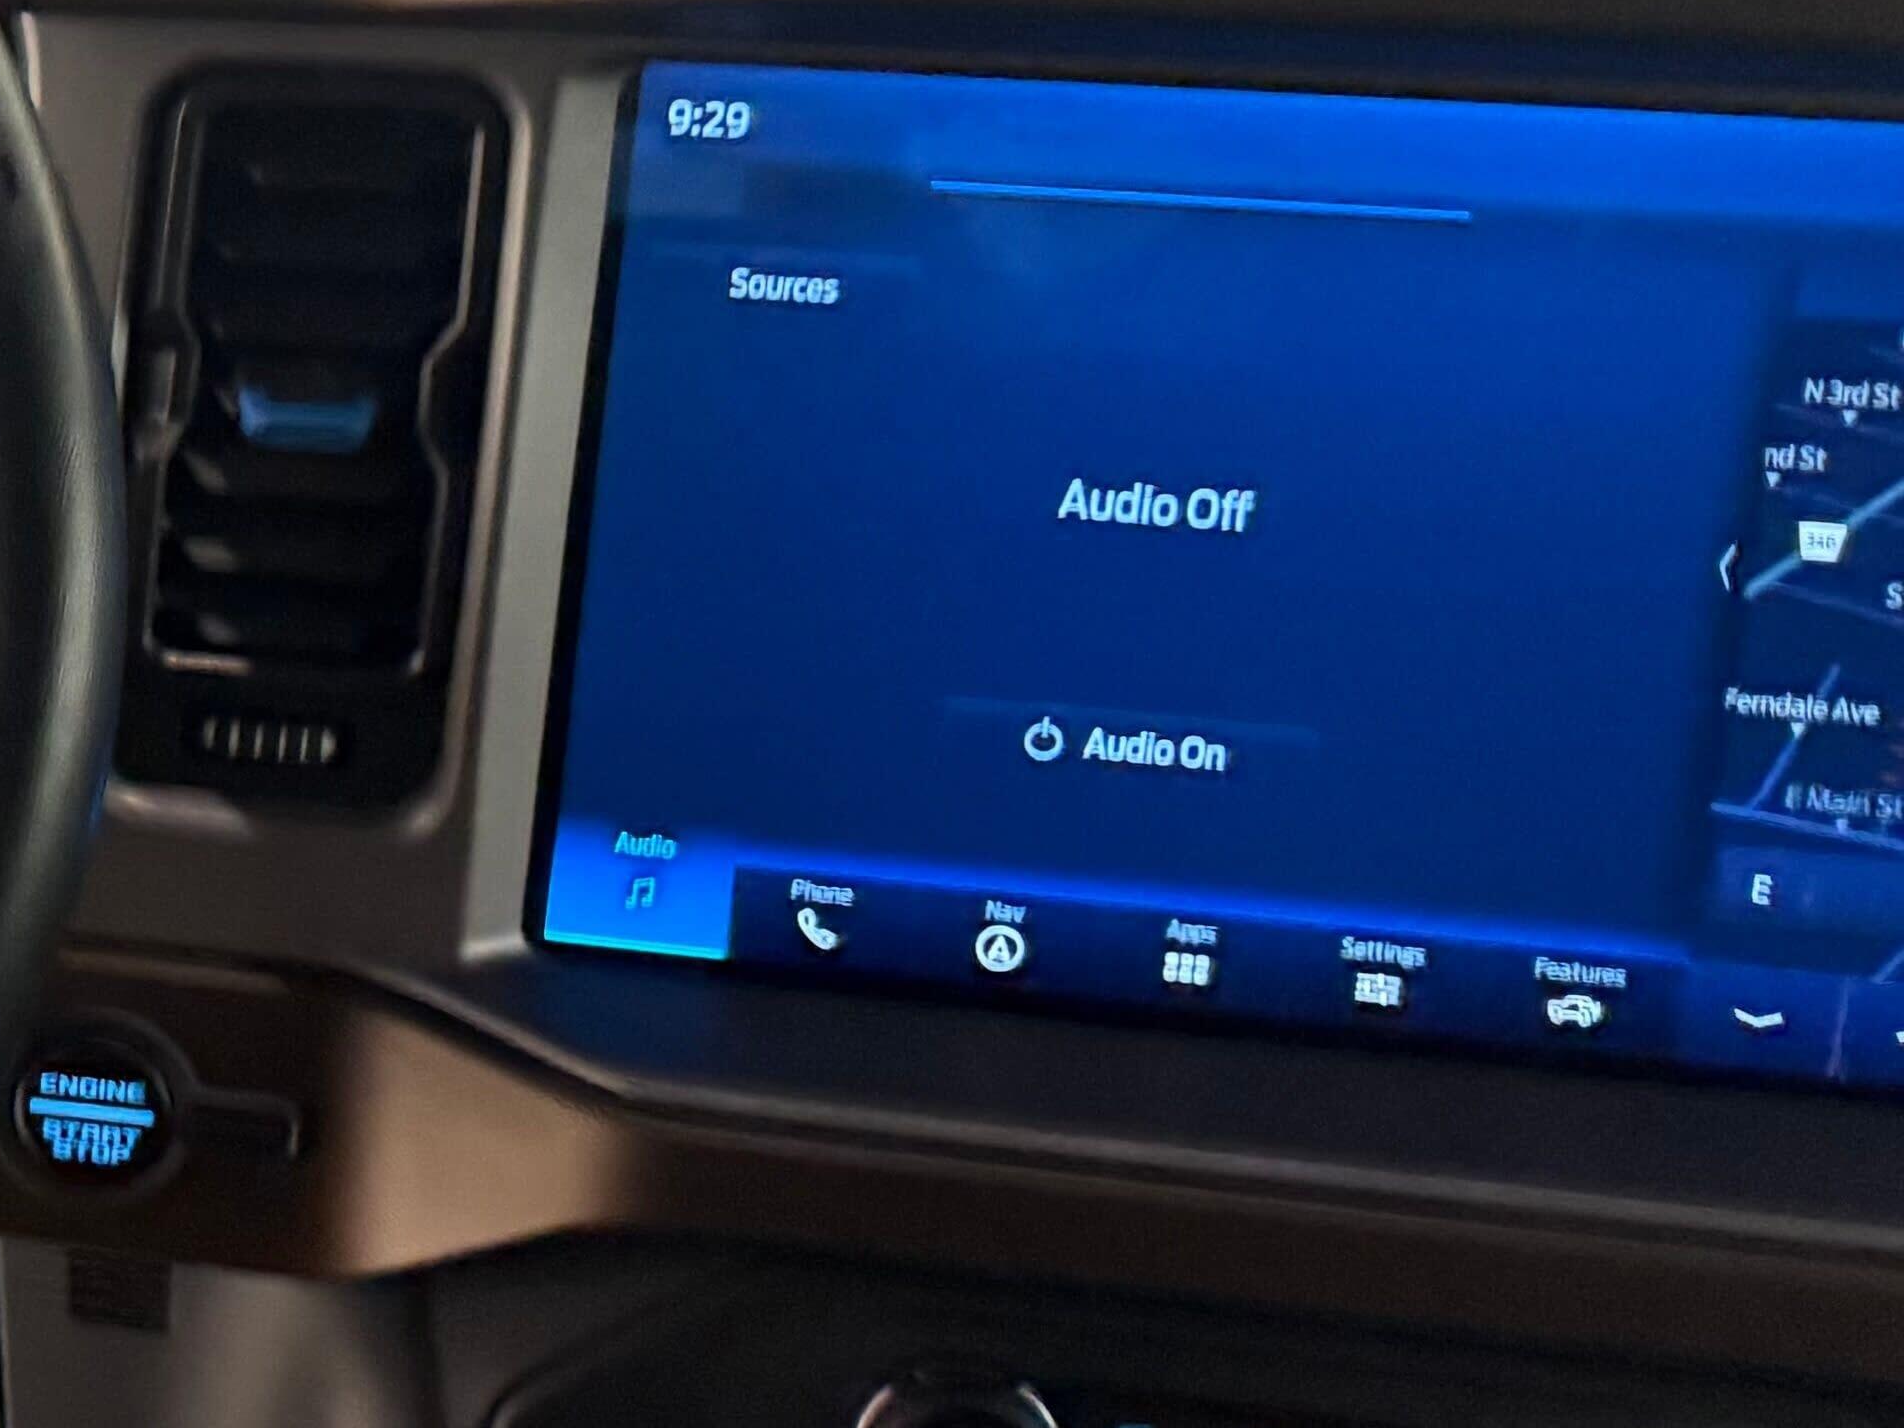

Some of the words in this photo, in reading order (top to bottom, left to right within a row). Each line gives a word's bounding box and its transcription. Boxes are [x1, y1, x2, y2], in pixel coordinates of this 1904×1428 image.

[668, 98, 751, 140] 9:29
[729, 267, 841, 305] Sources
[1803, 376, 1825, 404] N
[1826, 378, 1871, 408] 3rd
[1872, 382, 1903, 412] St
[1798, 445, 1829, 472] St
[1057, 477, 1180, 527] Audio
[1186, 487, 1257, 533] Off
[1725, 687, 1830, 722] Ferndale
[1832, 696, 1882, 727] Ave
[1082, 726, 1176, 767] Audio
[1179, 734, 1227, 772] On
[614, 830, 678, 861] Audio
[790, 877, 857, 908] Phone
[1751, 873, 1774, 906] E
[984, 899, 1027, 925] Nav
[1165, 917, 1219, 946] Apps
[1340, 935, 1428, 969] Settings
[1534, 955, 1628, 989] Features
[39, 1071, 146, 1105] ENGINE
[42, 1115, 142, 1148] START
[52, 1139, 132, 1166] STOP
